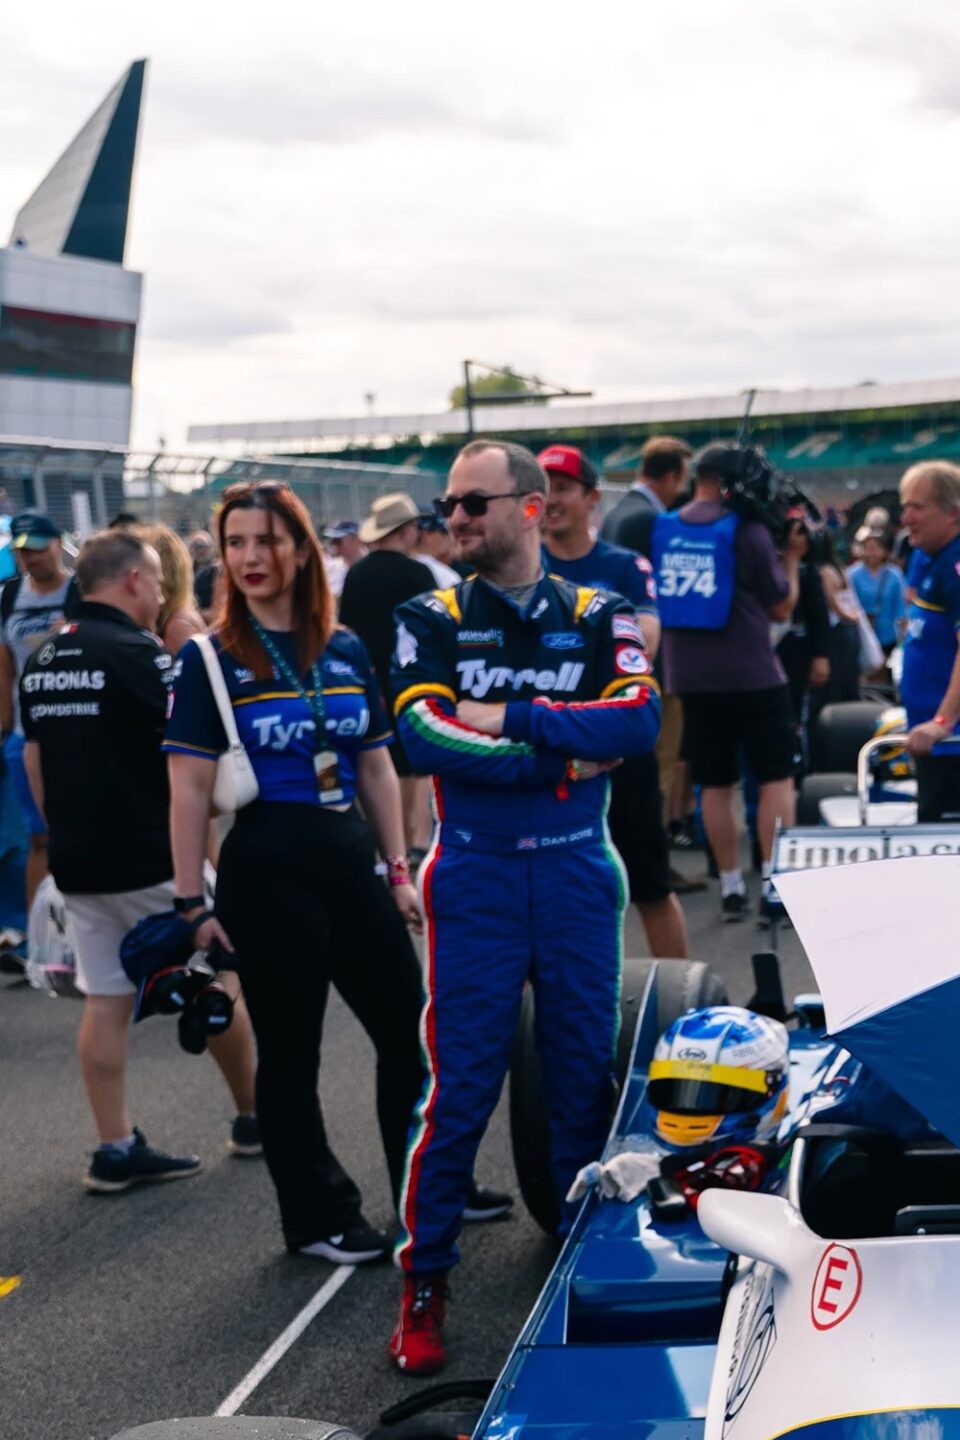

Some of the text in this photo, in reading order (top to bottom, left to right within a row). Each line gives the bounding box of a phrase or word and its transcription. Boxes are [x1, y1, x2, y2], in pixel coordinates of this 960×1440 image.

[661, 553, 715, 570] MEDIA
[659, 569, 718, 599] 374
[23, 670, 106, 693] ETRONAS
[456, 659, 586, 699] Tyrrell
[788, 836, 919, 870] imola
[817, 1257, 848, 1313] E
